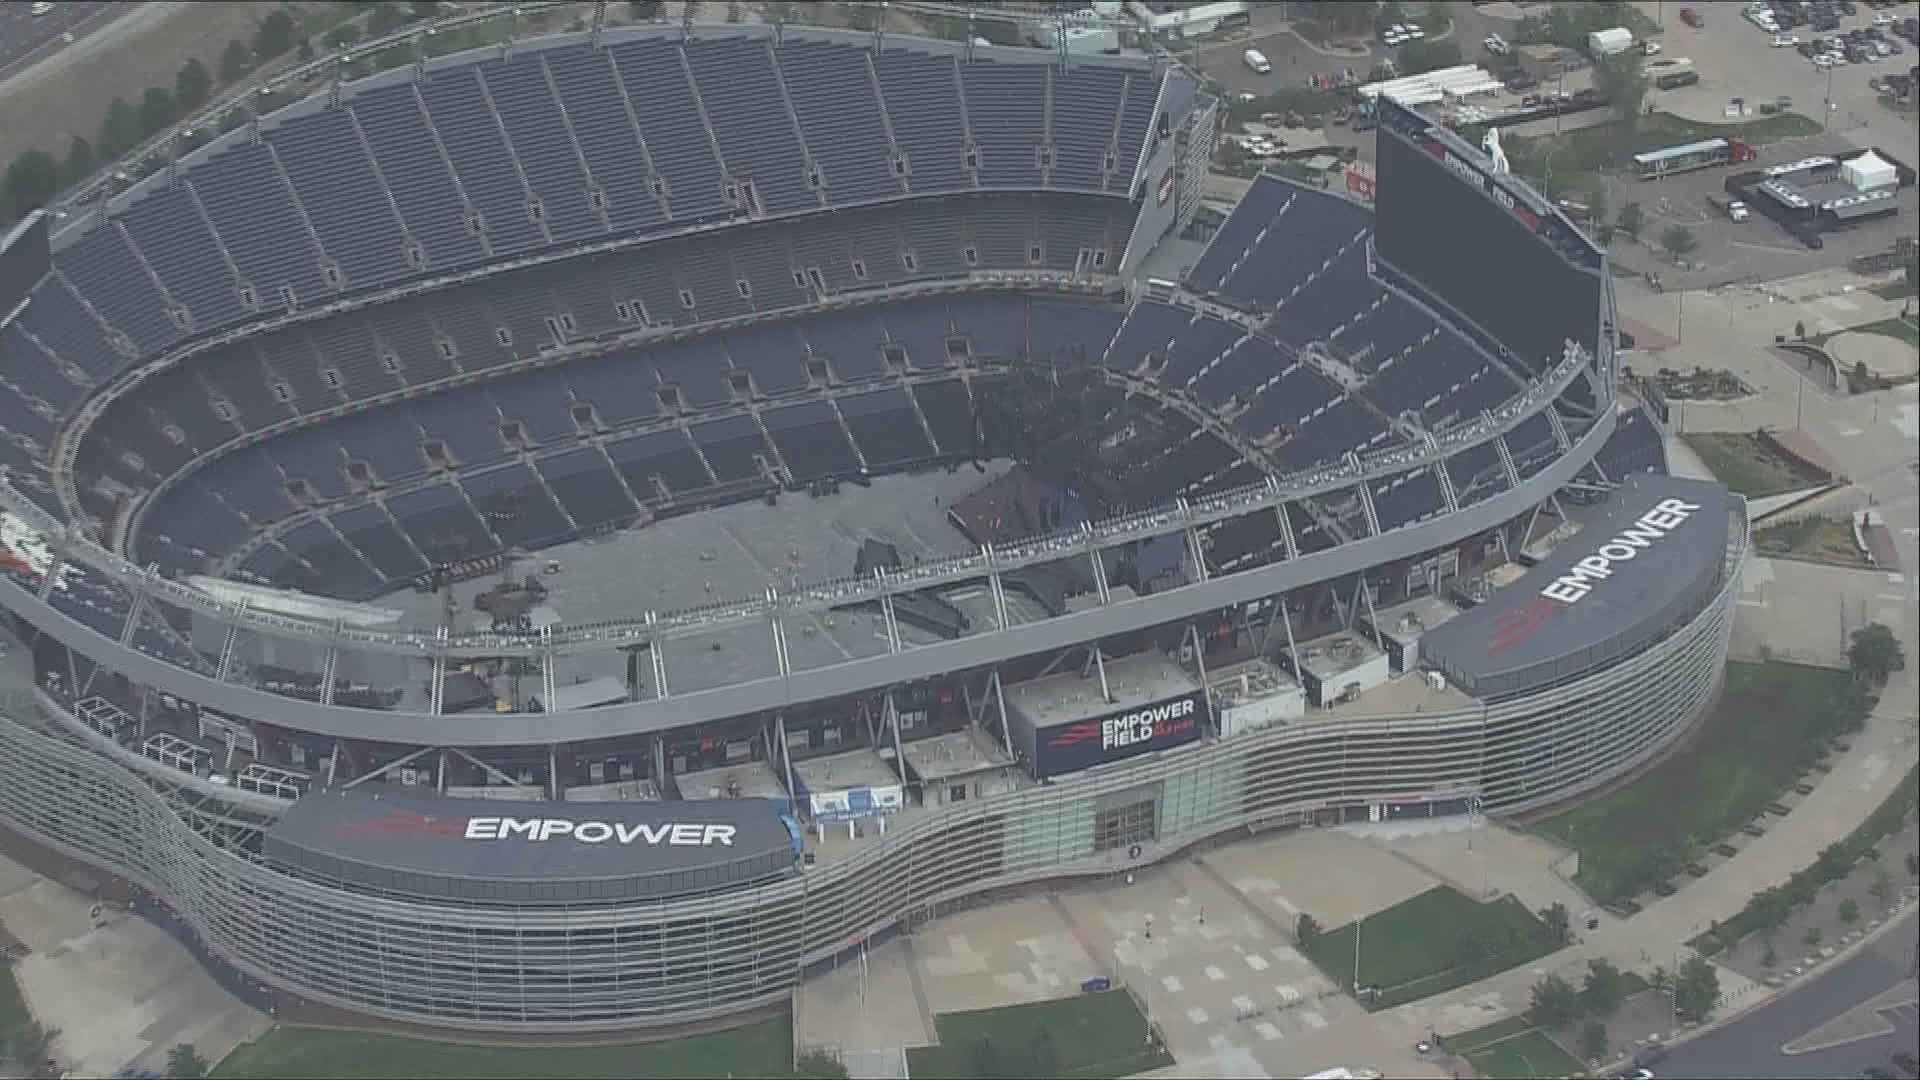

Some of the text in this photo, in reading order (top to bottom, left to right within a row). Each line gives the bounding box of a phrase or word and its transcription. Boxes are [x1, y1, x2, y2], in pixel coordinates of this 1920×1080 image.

[1540, 497, 1703, 604] EMPOWER
[1102, 699, 1195, 734] EMPOWER
[1103, 726, 1153, 750] FIELD
[464, 816, 737, 847] EMPOWER
